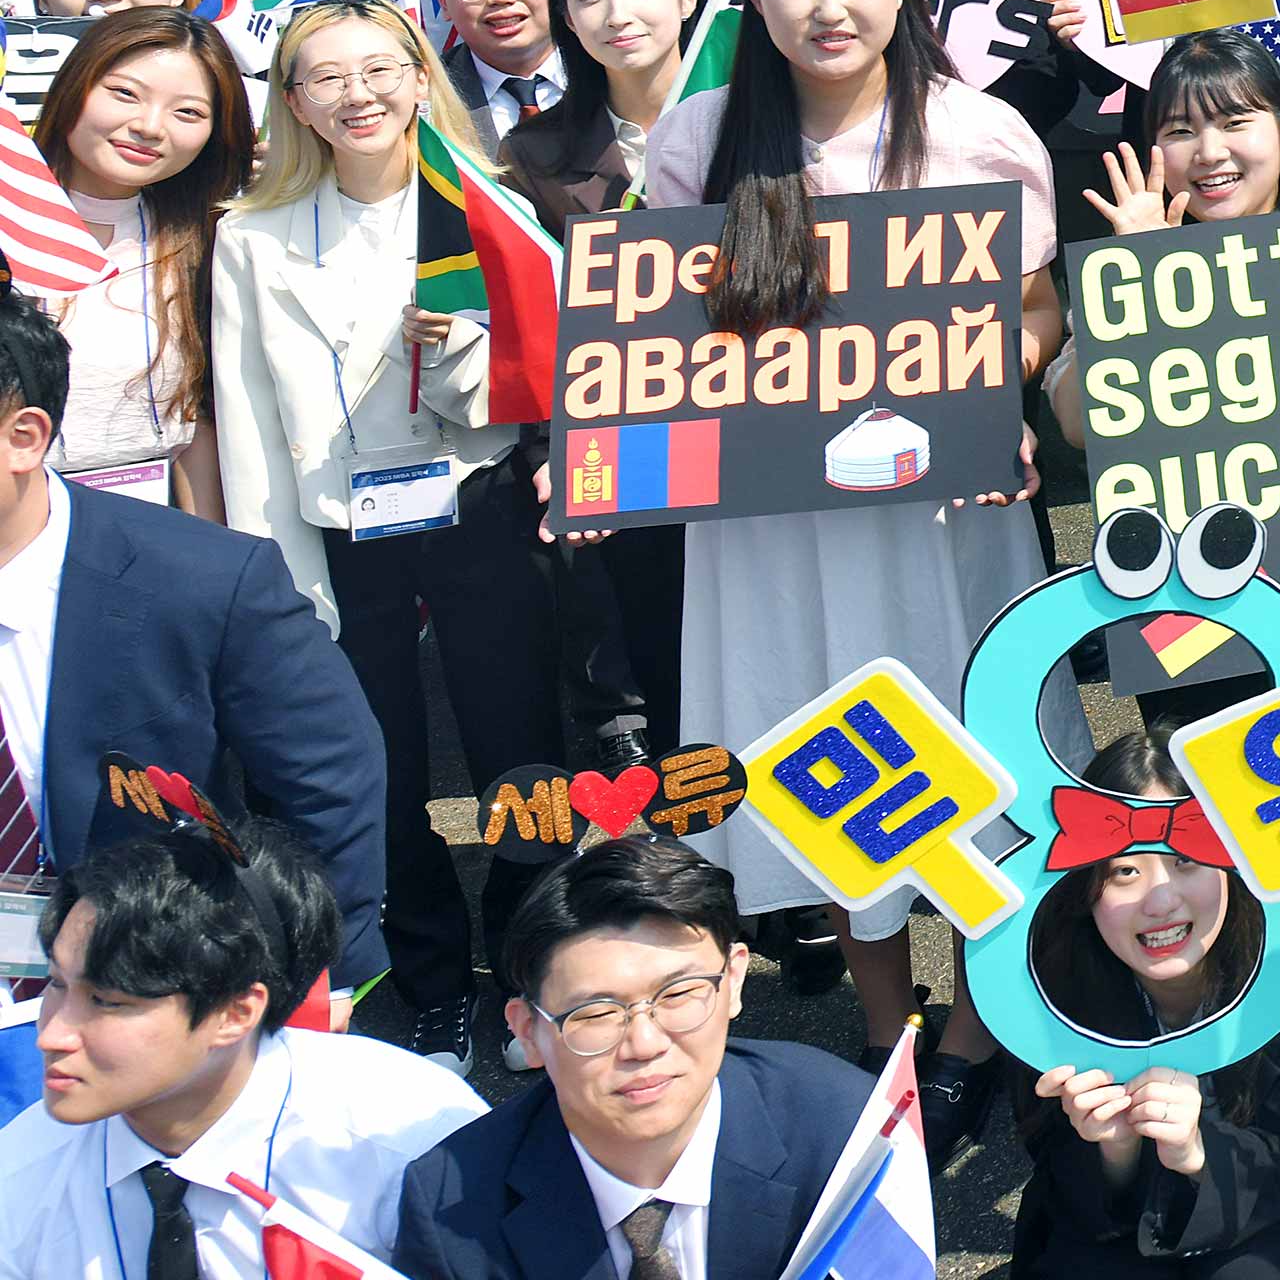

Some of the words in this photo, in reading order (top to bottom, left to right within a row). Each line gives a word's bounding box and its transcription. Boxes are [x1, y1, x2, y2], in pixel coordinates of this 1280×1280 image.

[885, 209, 1008, 289] их
[563, 303, 1005, 420] аваарай
[771, 698, 960, 865] 믿
